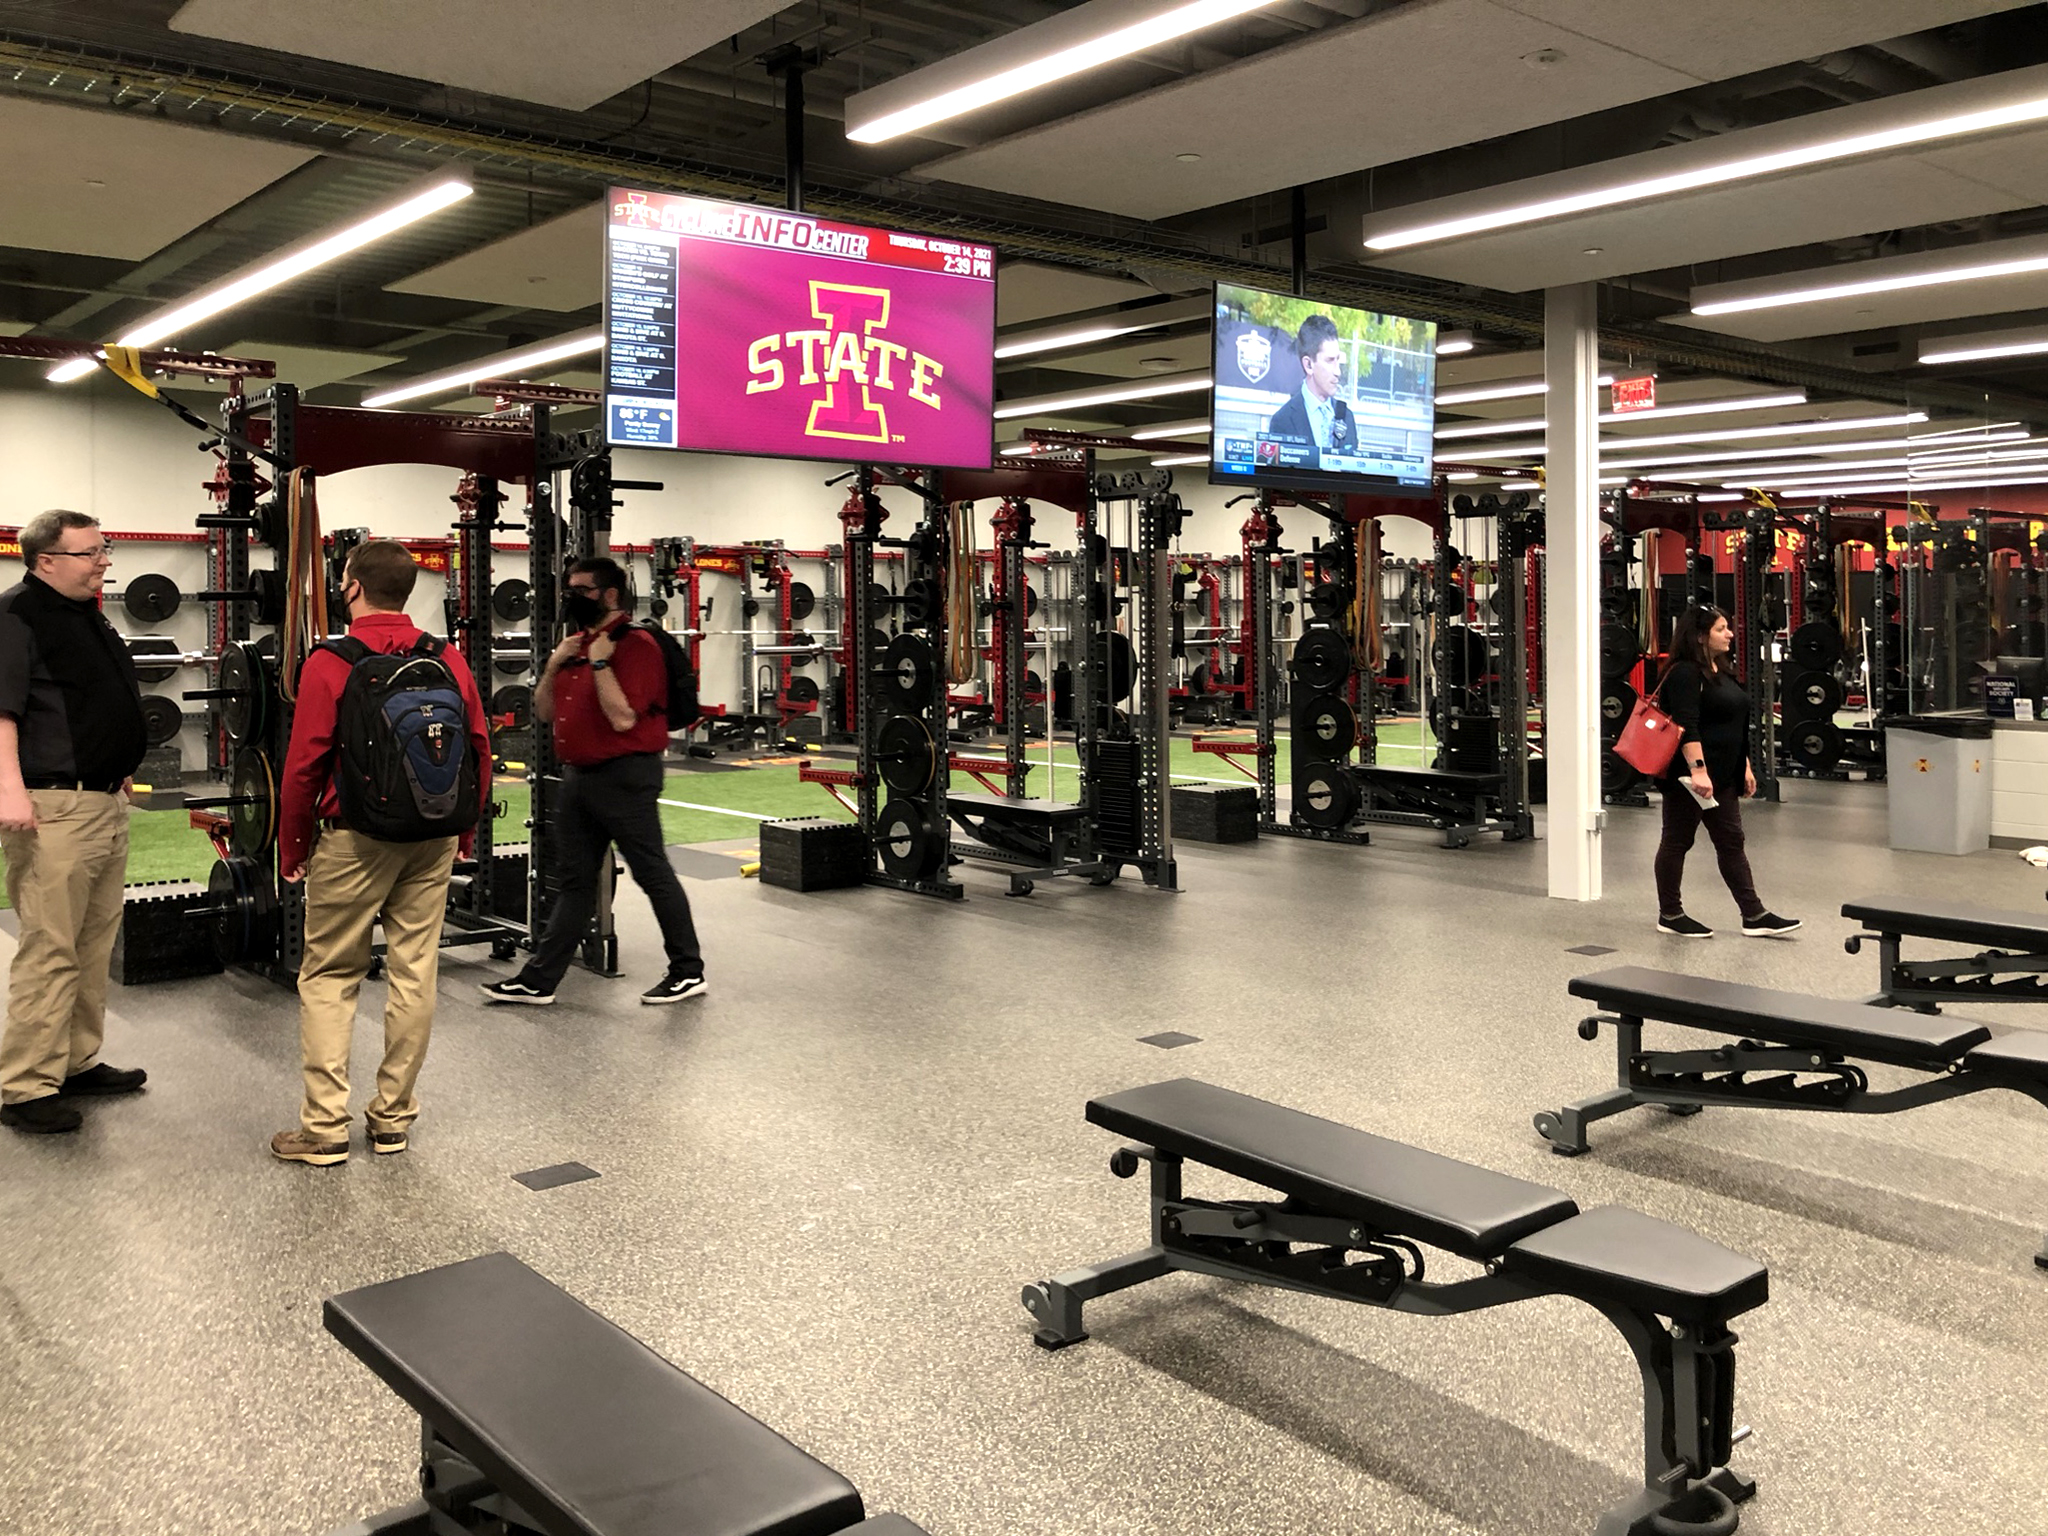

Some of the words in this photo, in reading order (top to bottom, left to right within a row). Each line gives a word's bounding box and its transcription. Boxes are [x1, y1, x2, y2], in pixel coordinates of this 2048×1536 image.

[735, 213, 812, 248] INFO
[812, 228, 870, 257] CENTER
[889, 234, 928, 252] THURSDAY,
[928, 241, 961, 255] OCTOBER
[973, 247, 991, 260] 2021
[943, 256, 971, 275] 2:39
[973, 260, 991, 278] PM
[746, 330, 943, 411] STATE
